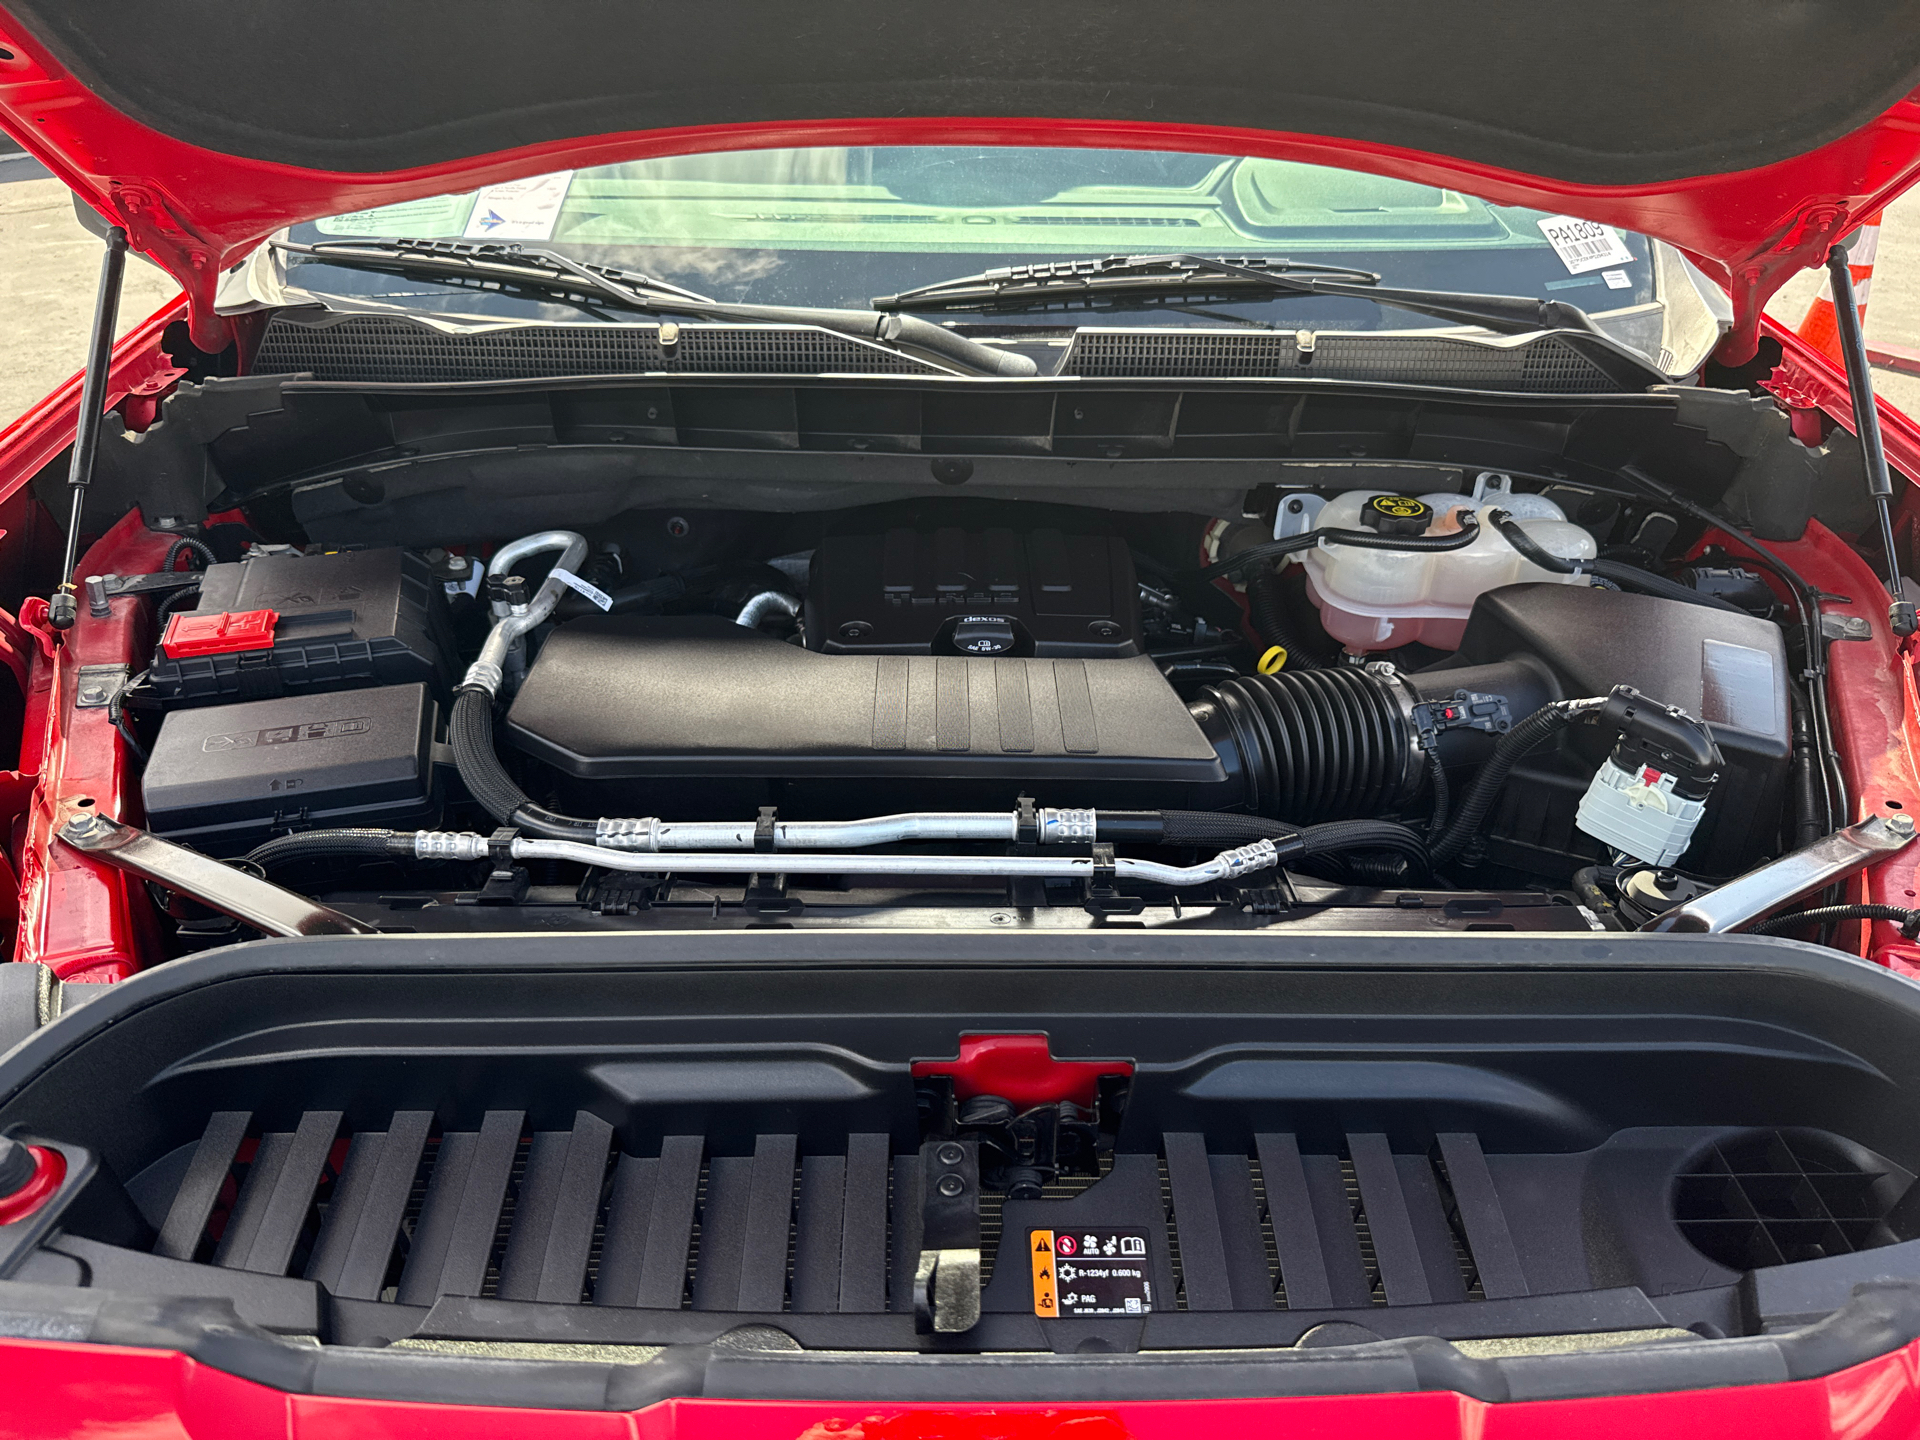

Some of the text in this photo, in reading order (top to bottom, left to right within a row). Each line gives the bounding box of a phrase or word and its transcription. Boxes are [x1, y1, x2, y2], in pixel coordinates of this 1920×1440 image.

[1547, 221, 1604, 246] PA1809
[1078, 1269, 1141, 1278] R-1234yf 0.600 kg
[1081, 1295, 1096, 1303] PAG
